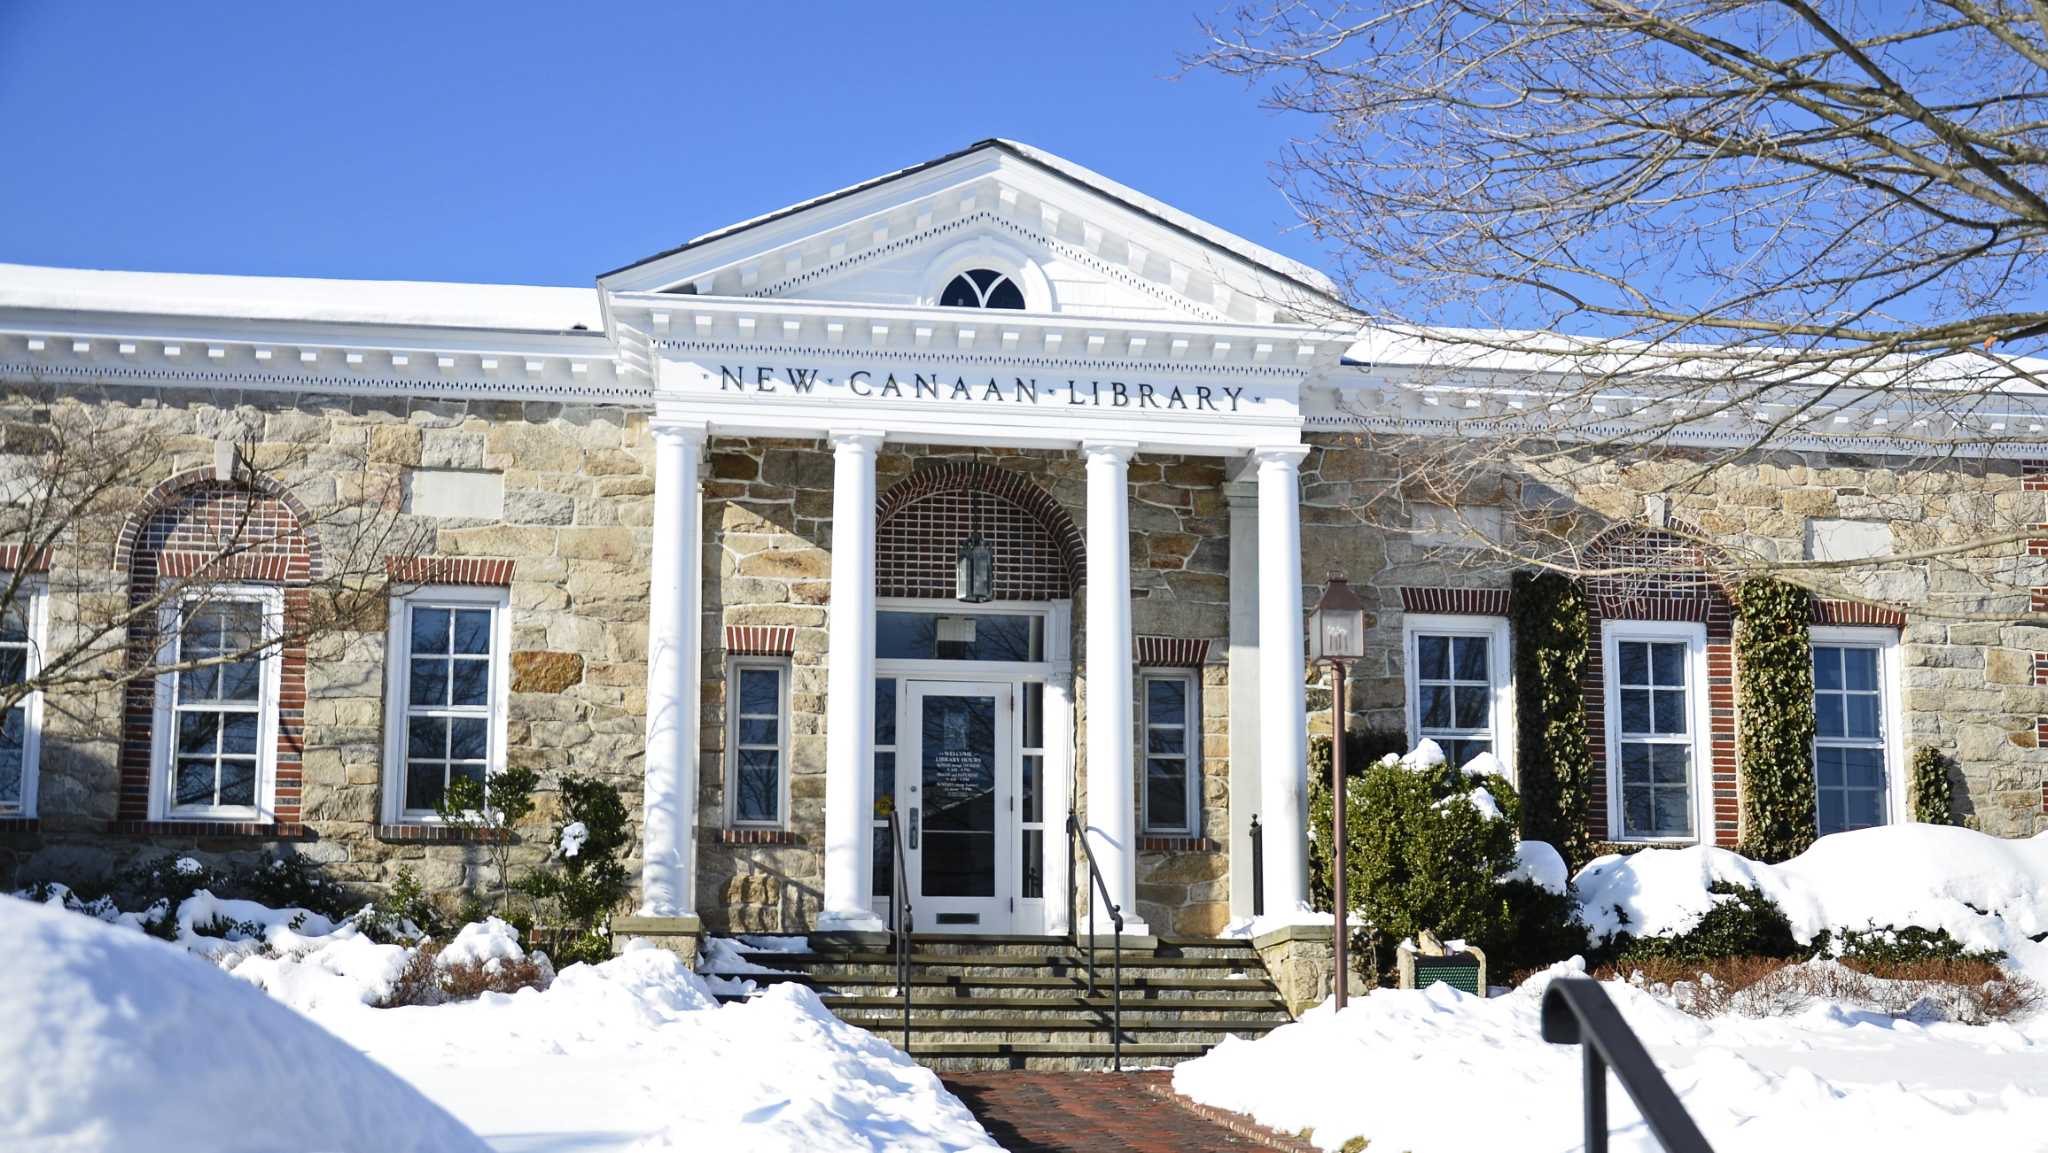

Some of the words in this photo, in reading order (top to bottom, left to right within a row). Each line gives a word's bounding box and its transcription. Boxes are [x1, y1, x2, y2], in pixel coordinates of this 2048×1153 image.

[720, 365, 819, 394] NEW
[849, 370, 1038, 405] CANAAN
[1067, 379, 1243, 412] LIBRARY
